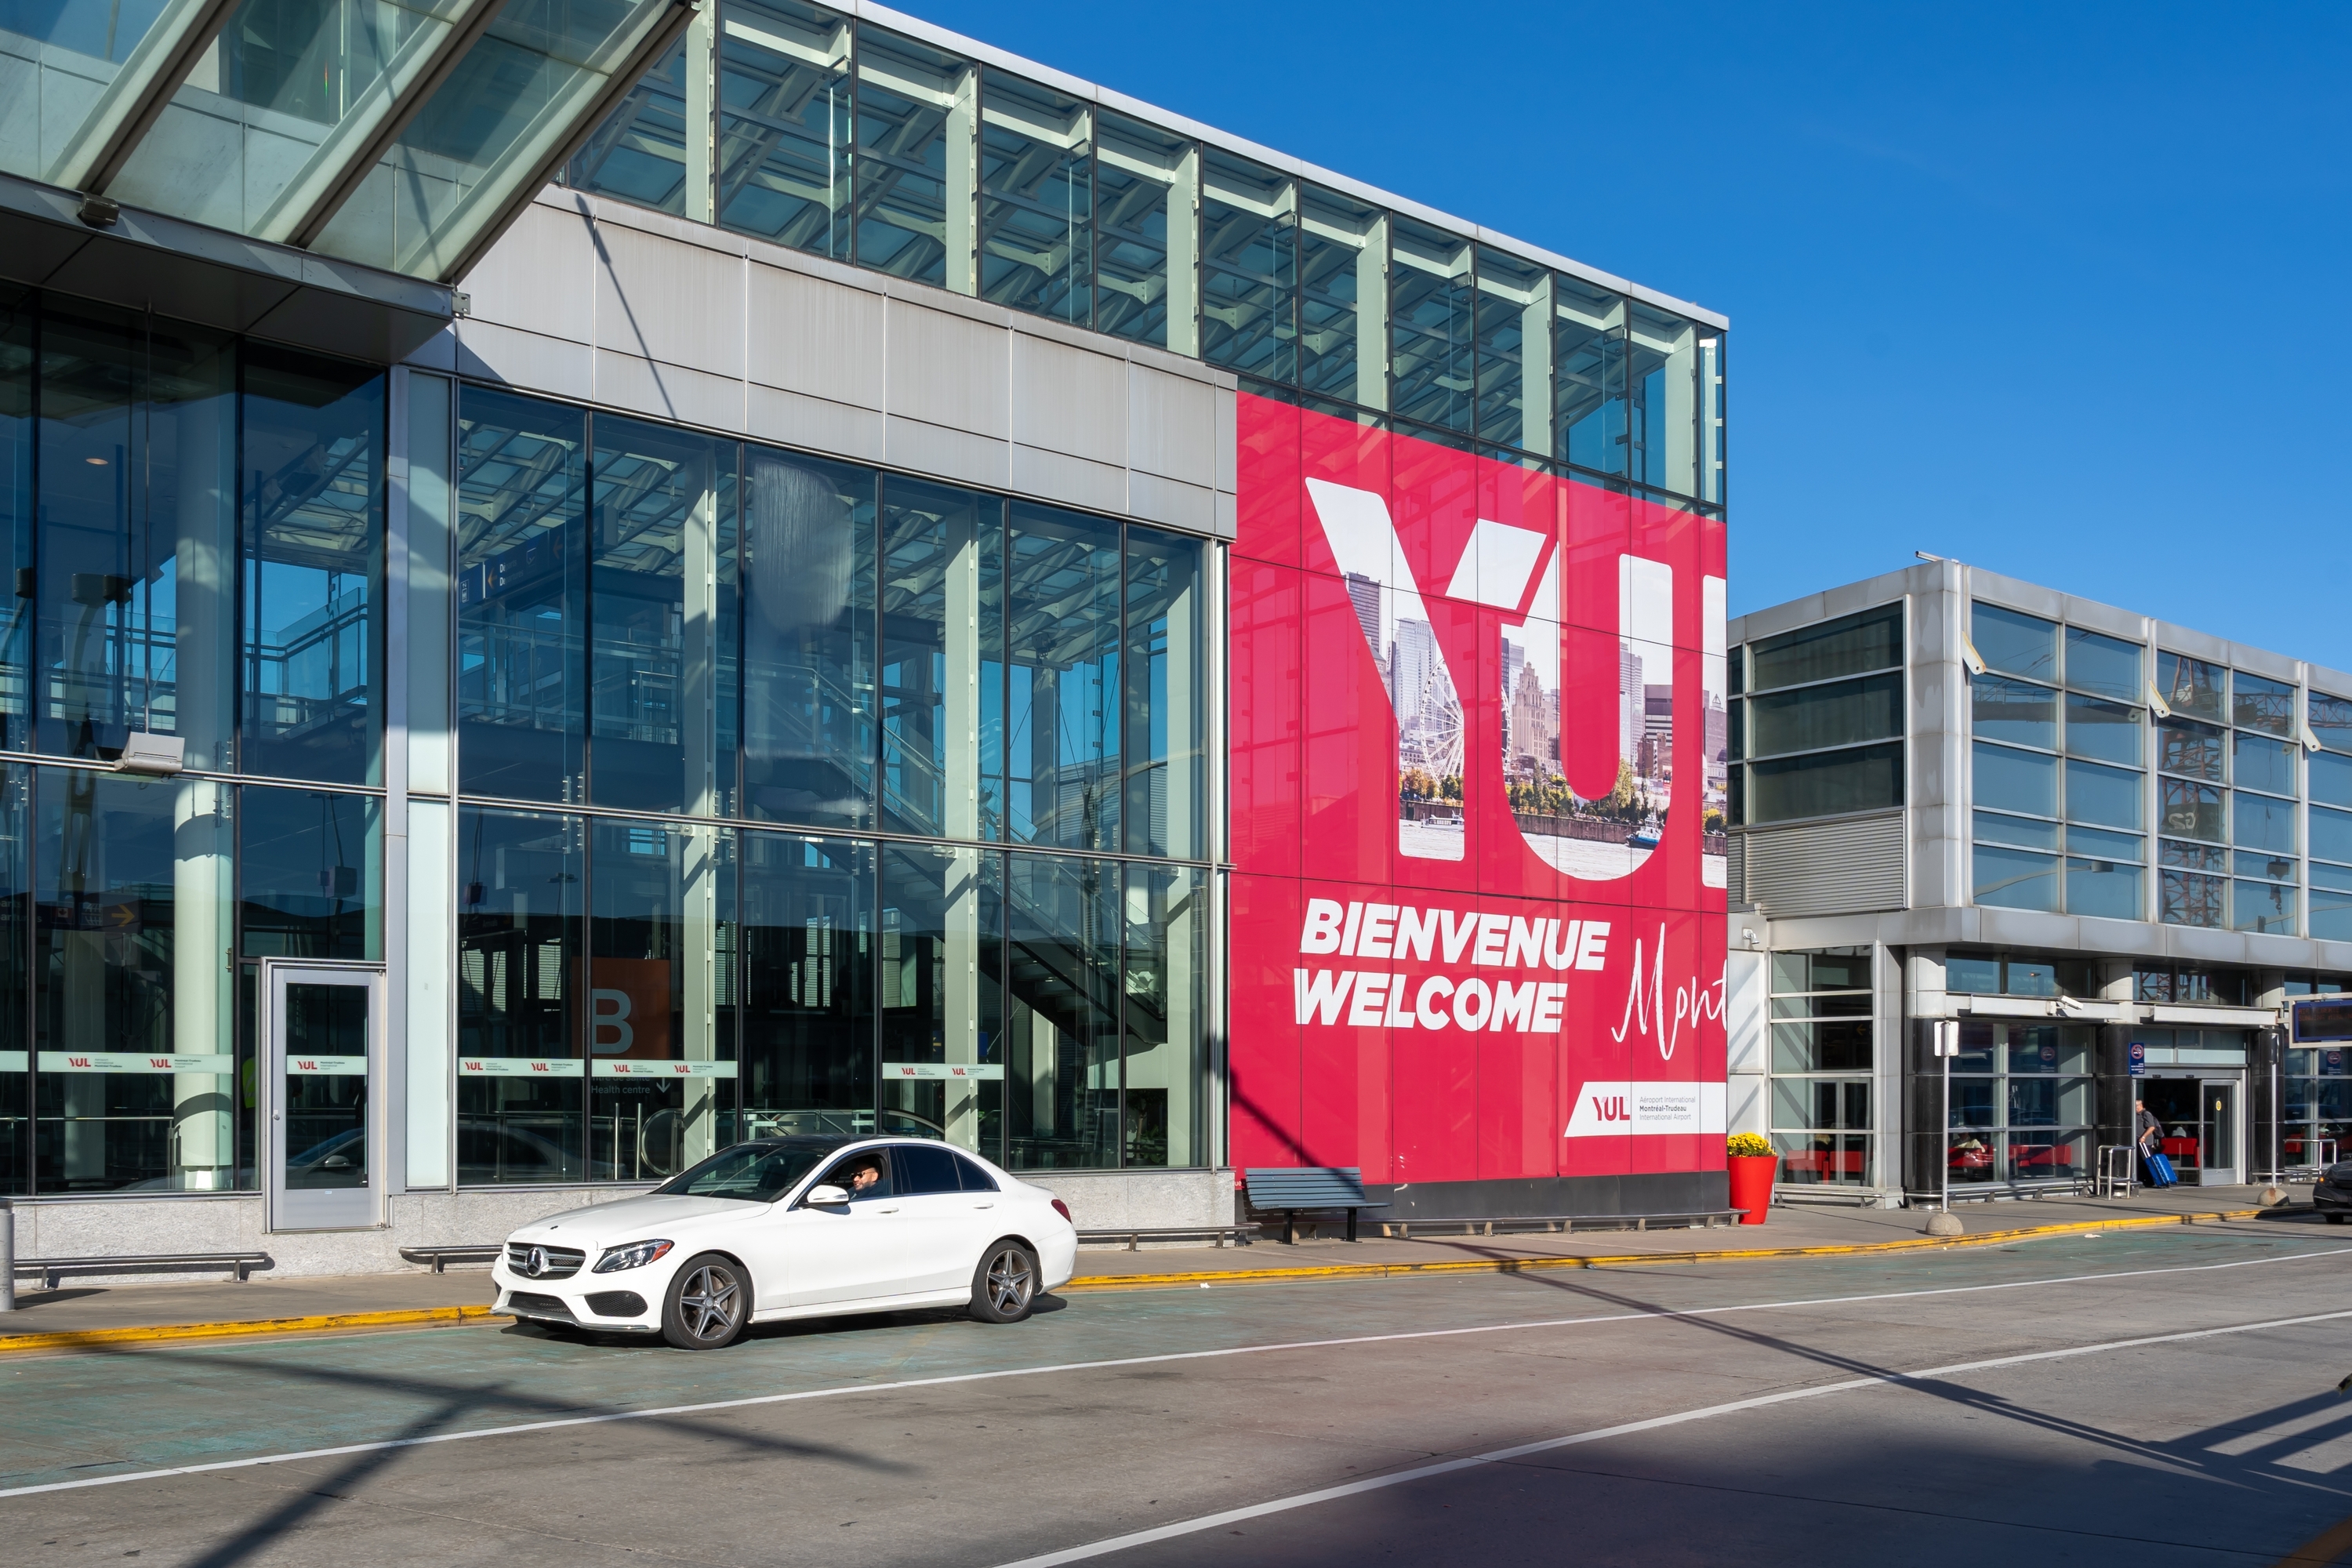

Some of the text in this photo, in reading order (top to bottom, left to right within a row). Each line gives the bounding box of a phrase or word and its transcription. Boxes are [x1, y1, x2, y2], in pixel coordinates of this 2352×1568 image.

[1299, 898, 1611, 971] BIENVENUE
[1294, 968, 1568, 1033] WELCOME
[591, 989, 633, 1054] B
[69, 1058, 91, 1067] YUL
[150, 1059, 171, 1068] YUL
[298, 1061, 318, 1070] YUL
[465, 1062, 483, 1071] YUL
[532, 1063, 549, 1072] YUL
[591, 1085, 651, 1094] Health centre
[1592, 1097, 1631, 1122] YUL
